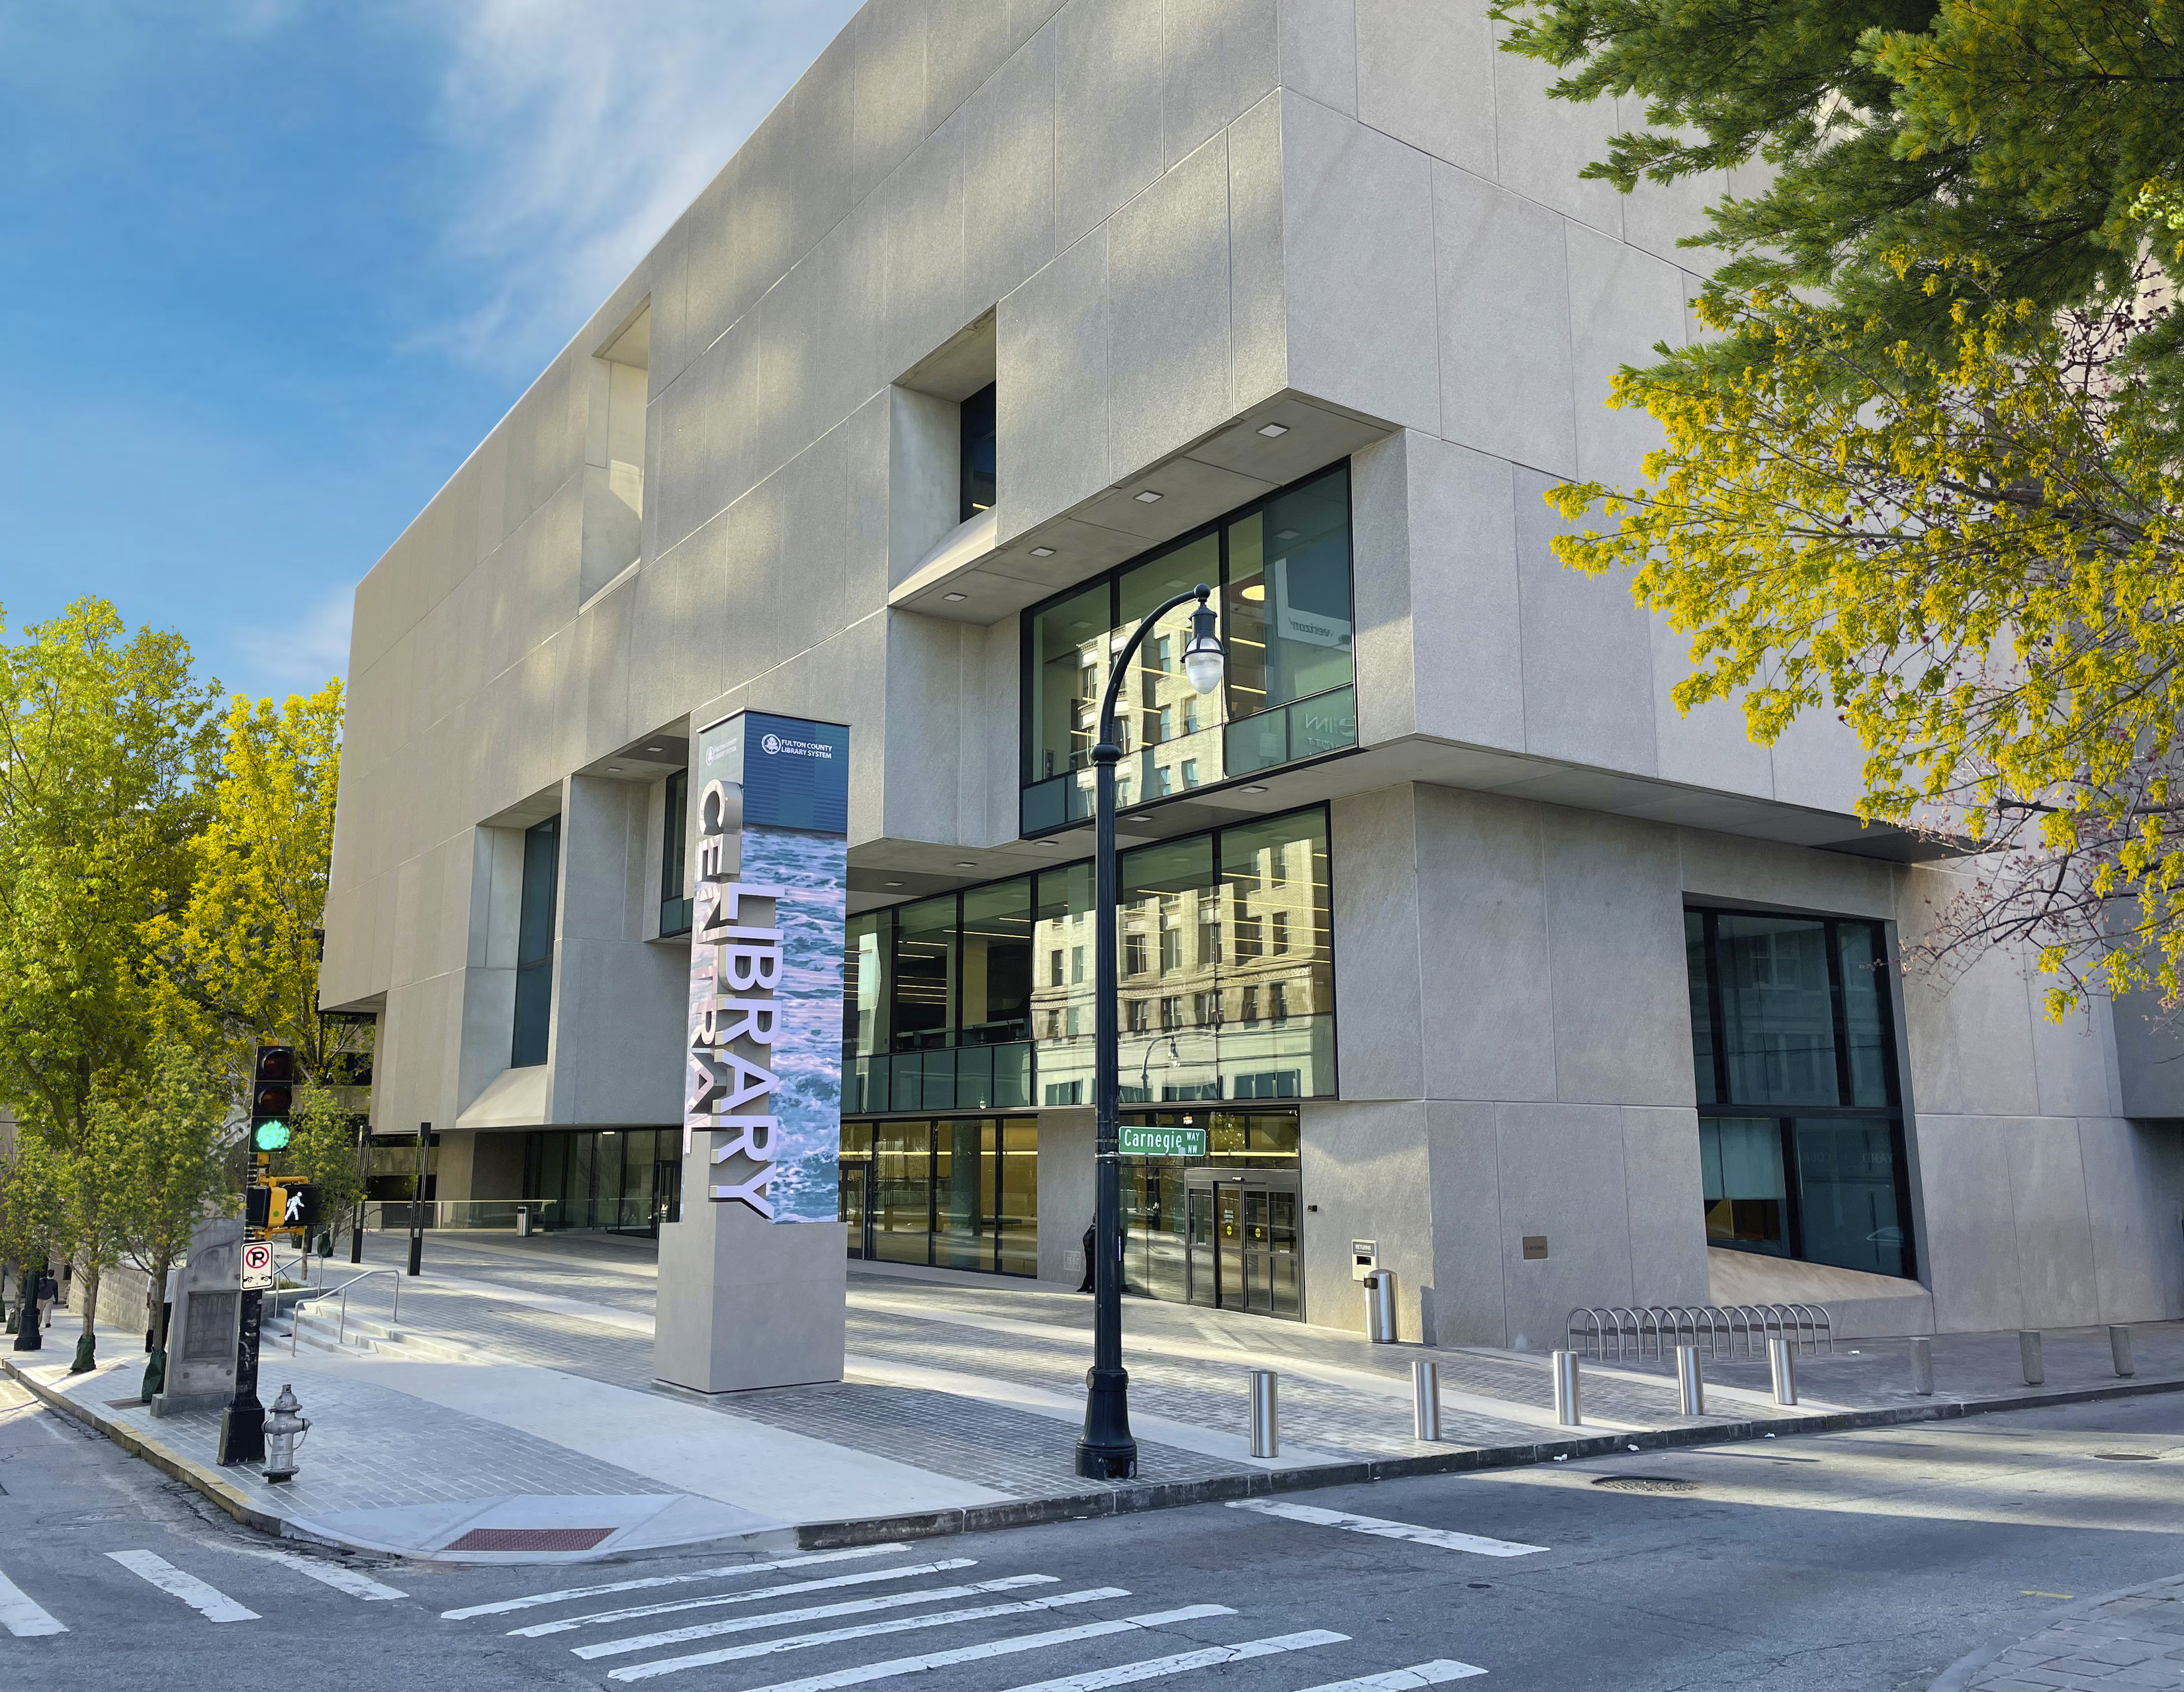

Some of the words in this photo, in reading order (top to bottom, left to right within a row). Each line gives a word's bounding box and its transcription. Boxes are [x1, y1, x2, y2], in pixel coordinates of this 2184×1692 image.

[781, 739, 806, 748] FULTON
[807, 743, 833, 752] COUNTY
[781, 746, 807, 756] LIBRARY
[807, 750, 832, 759] SYSTEM
[685, 778, 732, 1154] CENTRAL
[715, 882, 786, 1219] LIBRARY
[1124, 1129, 1183, 1154] Carnegie
[1186, 1131, 1200, 1141] WAY
[1187, 1145, 1198, 1154] NW
